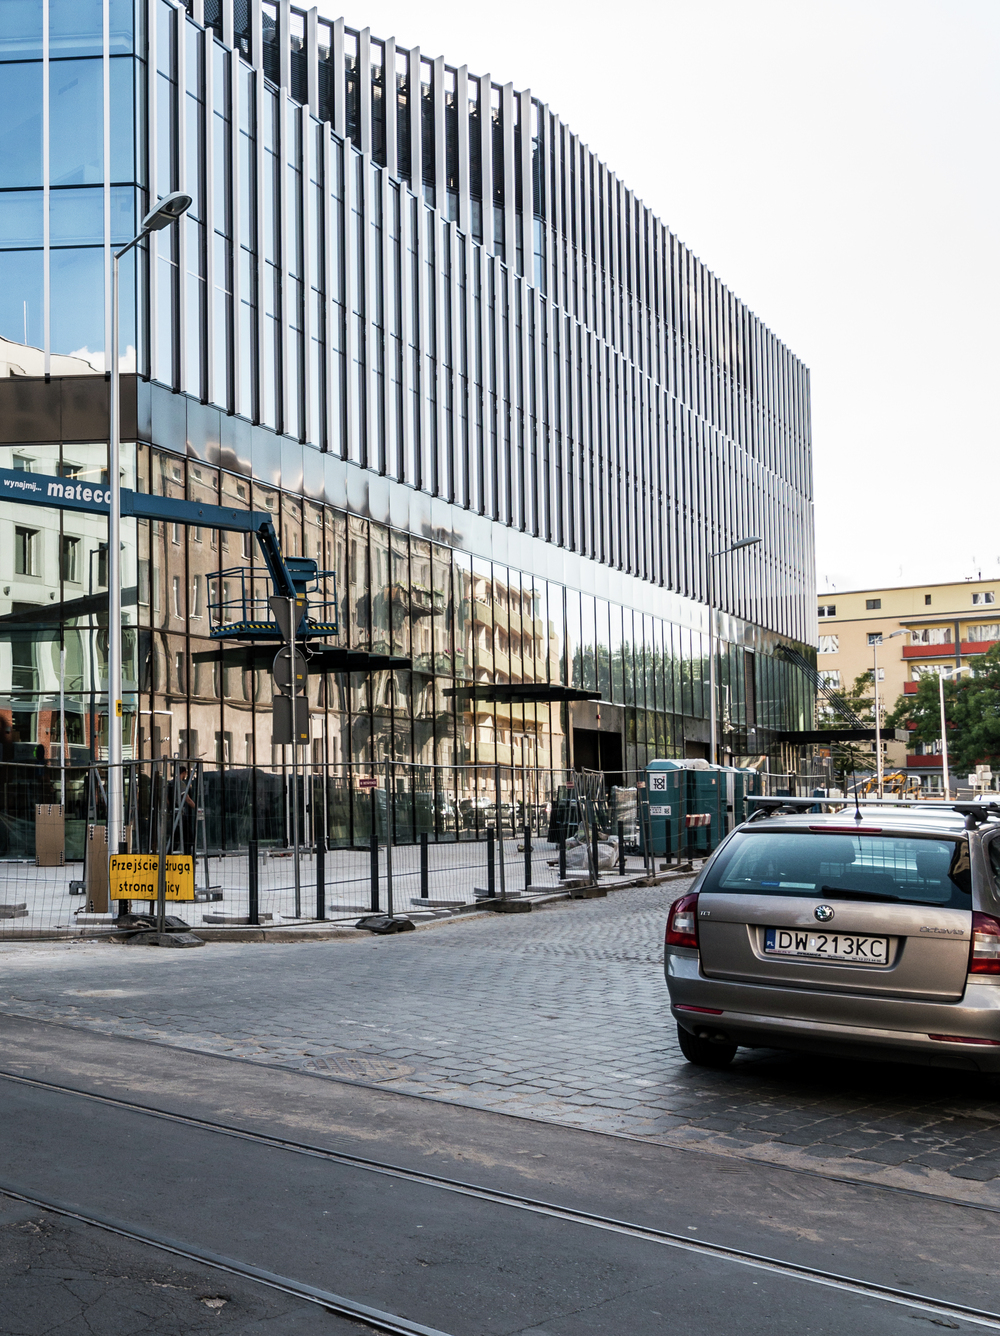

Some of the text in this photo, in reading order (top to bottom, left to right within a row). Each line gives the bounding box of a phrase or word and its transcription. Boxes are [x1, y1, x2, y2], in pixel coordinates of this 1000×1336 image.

[3, 478, 42, 492] wynajmij...
[112, 859, 191, 875] Przejście drugą
[118, 881, 180, 896] stroną licy
[779, 931, 883, 958] DW 213KC
